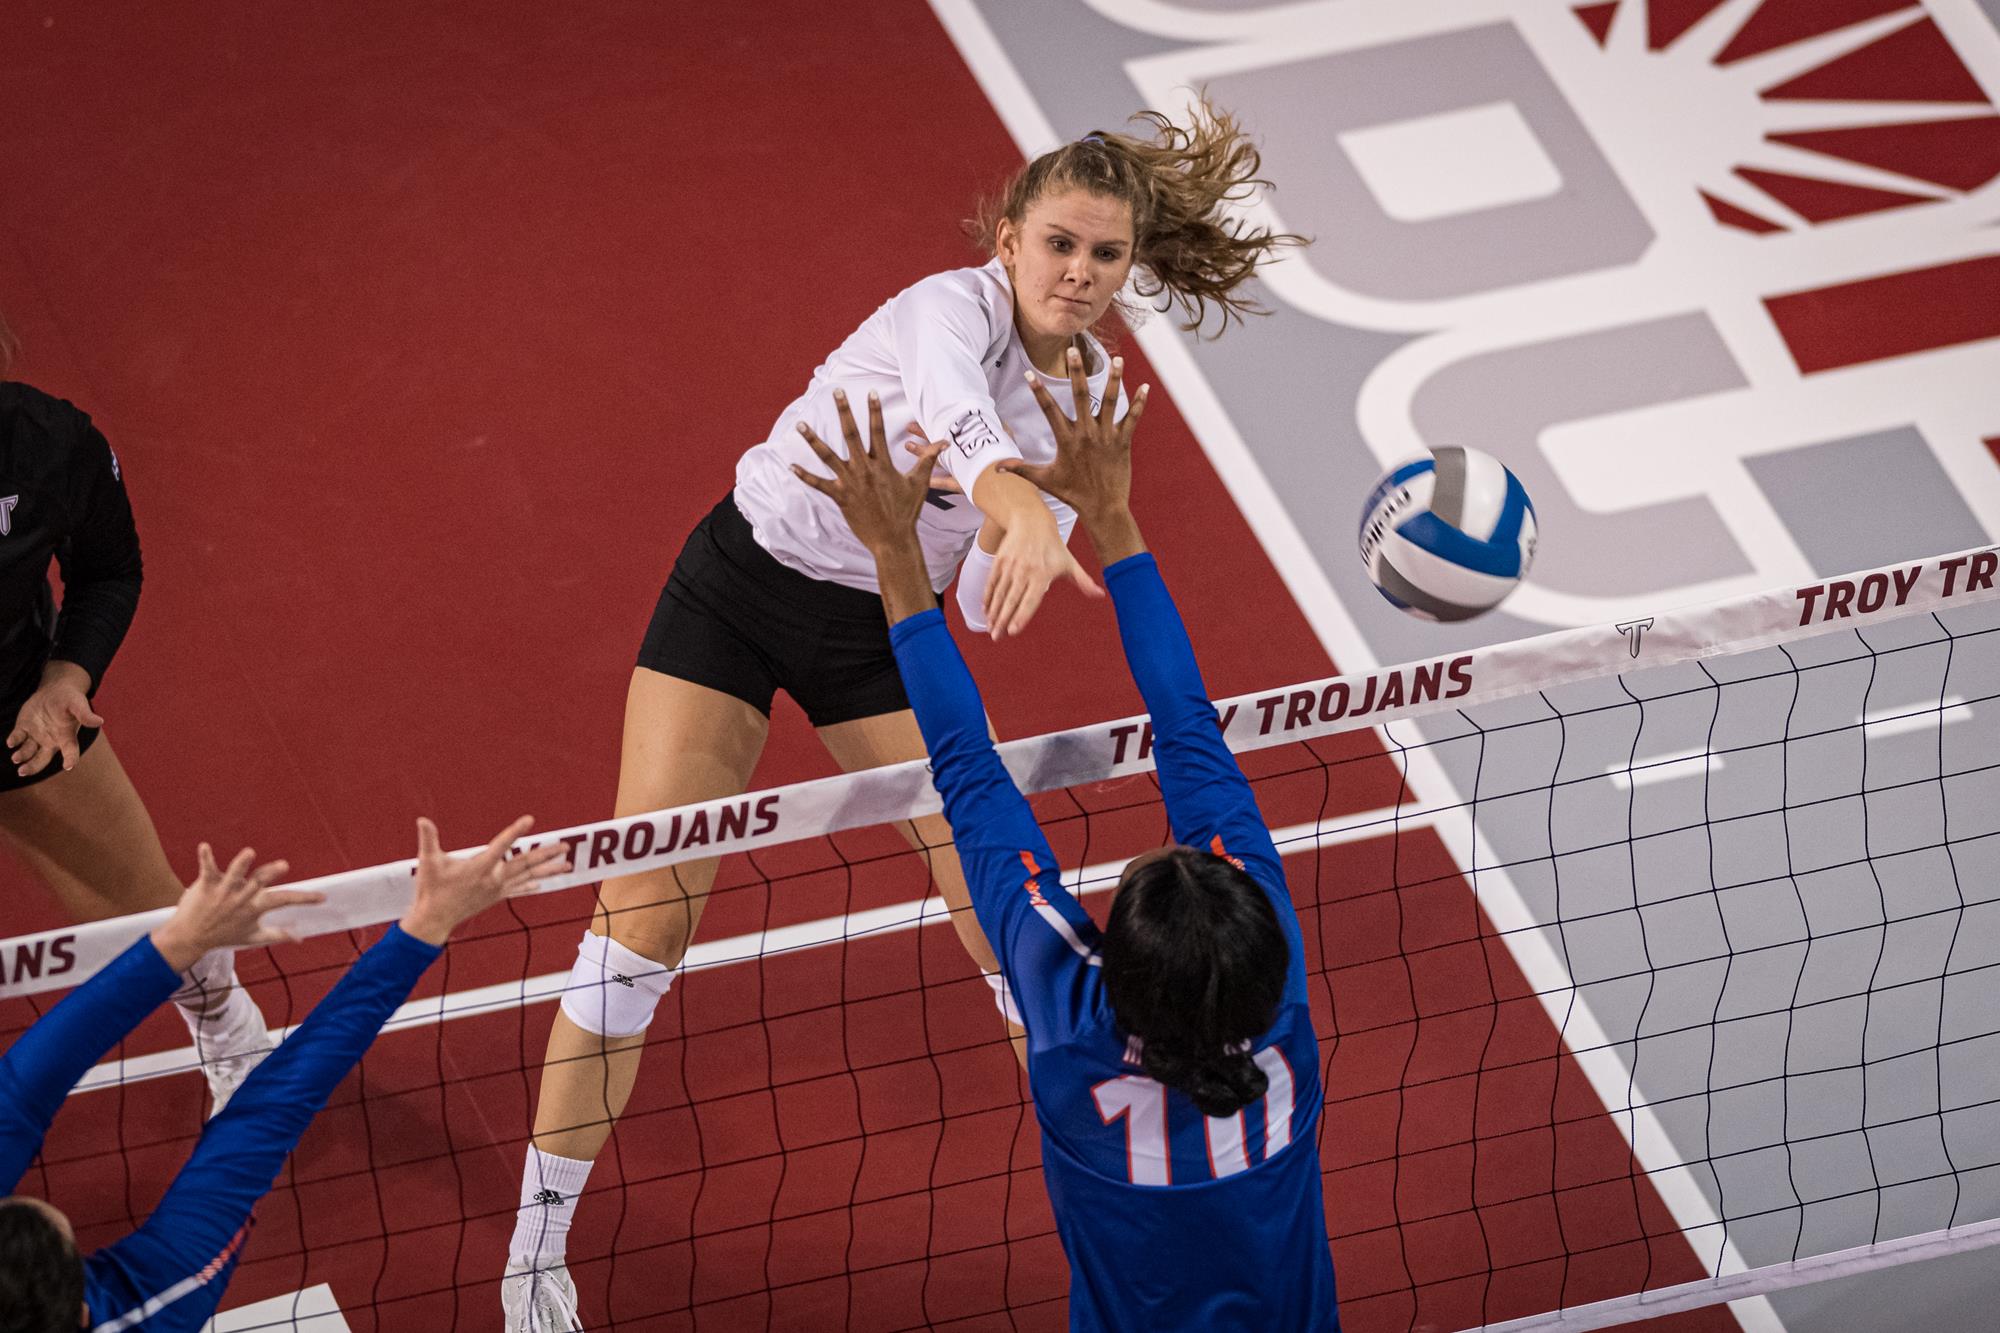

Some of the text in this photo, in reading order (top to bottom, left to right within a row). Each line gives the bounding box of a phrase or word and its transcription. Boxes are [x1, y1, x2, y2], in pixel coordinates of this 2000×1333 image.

[1796, 565, 1923, 627] TROY
[1255, 655, 1474, 736] TROJANS
[558, 794, 780, 874] TROJANS
